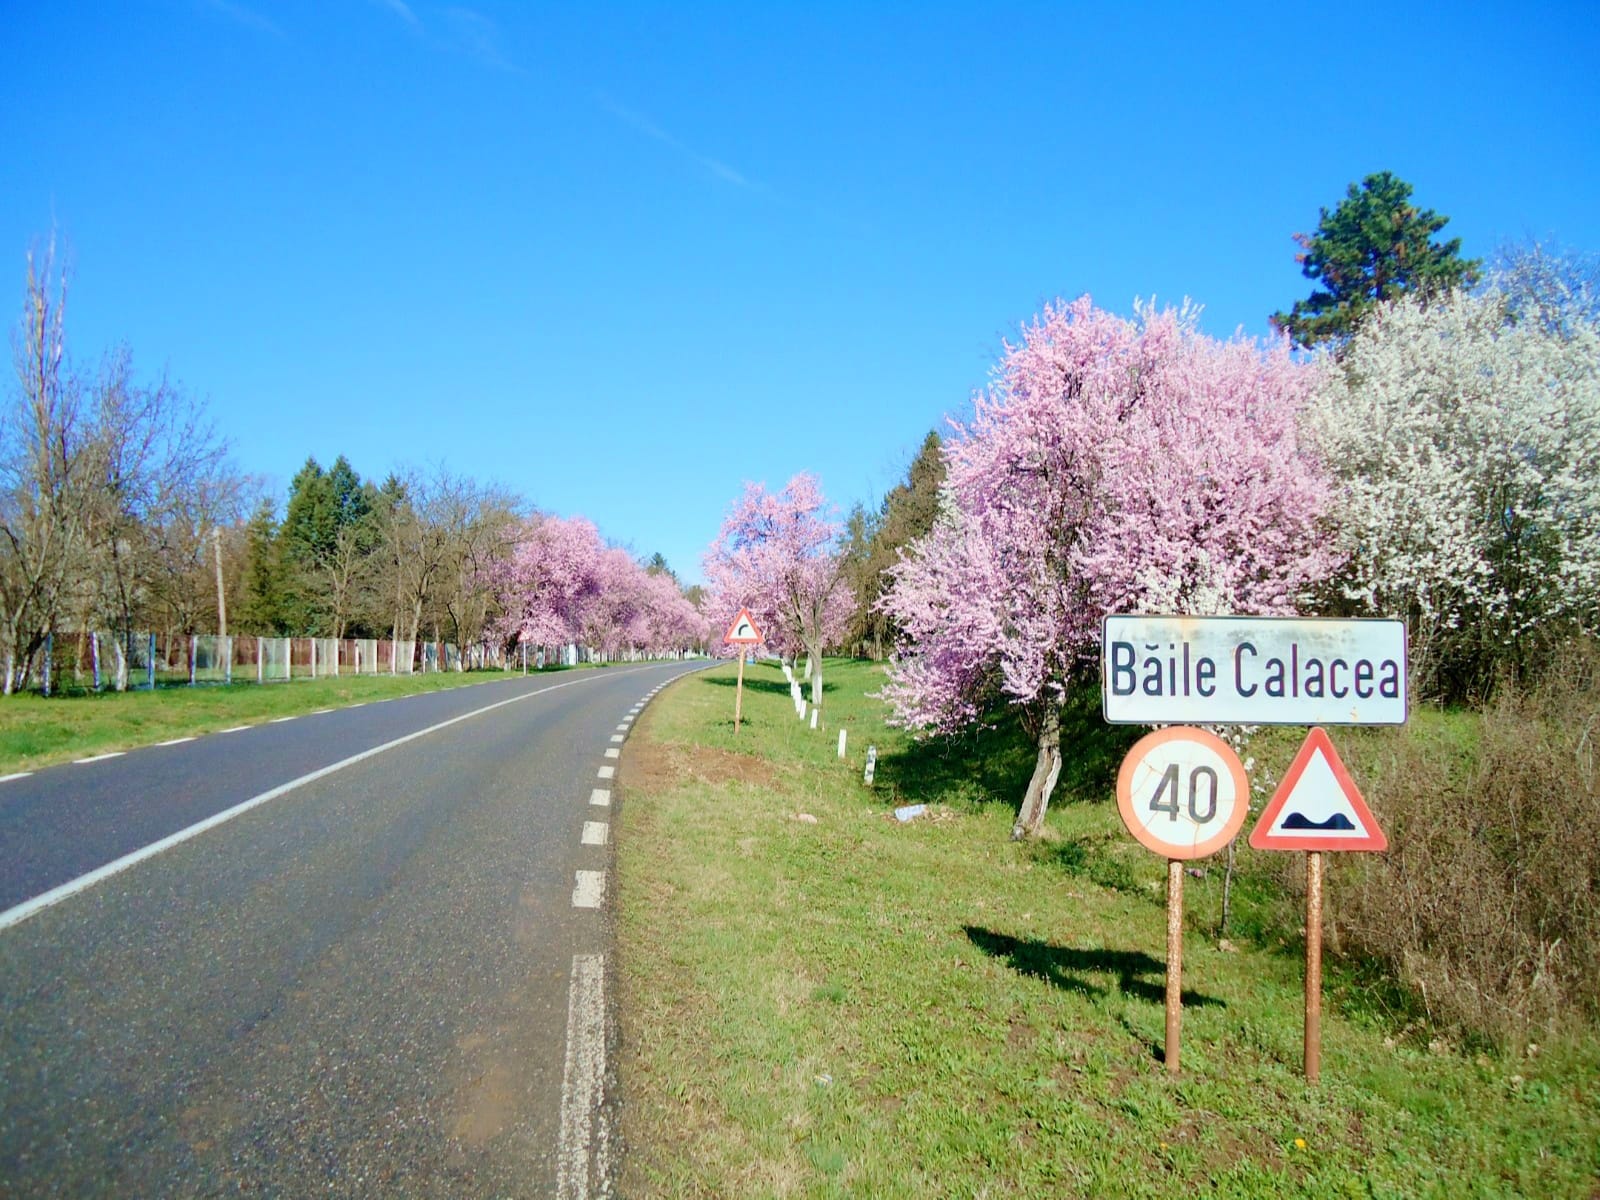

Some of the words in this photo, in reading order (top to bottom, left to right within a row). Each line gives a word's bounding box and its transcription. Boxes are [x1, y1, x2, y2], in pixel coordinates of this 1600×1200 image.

[1111, 641, 1216, 698] Băile
[1234, 641, 1399, 699] Calacea
[1149, 763, 1218, 824] 40
